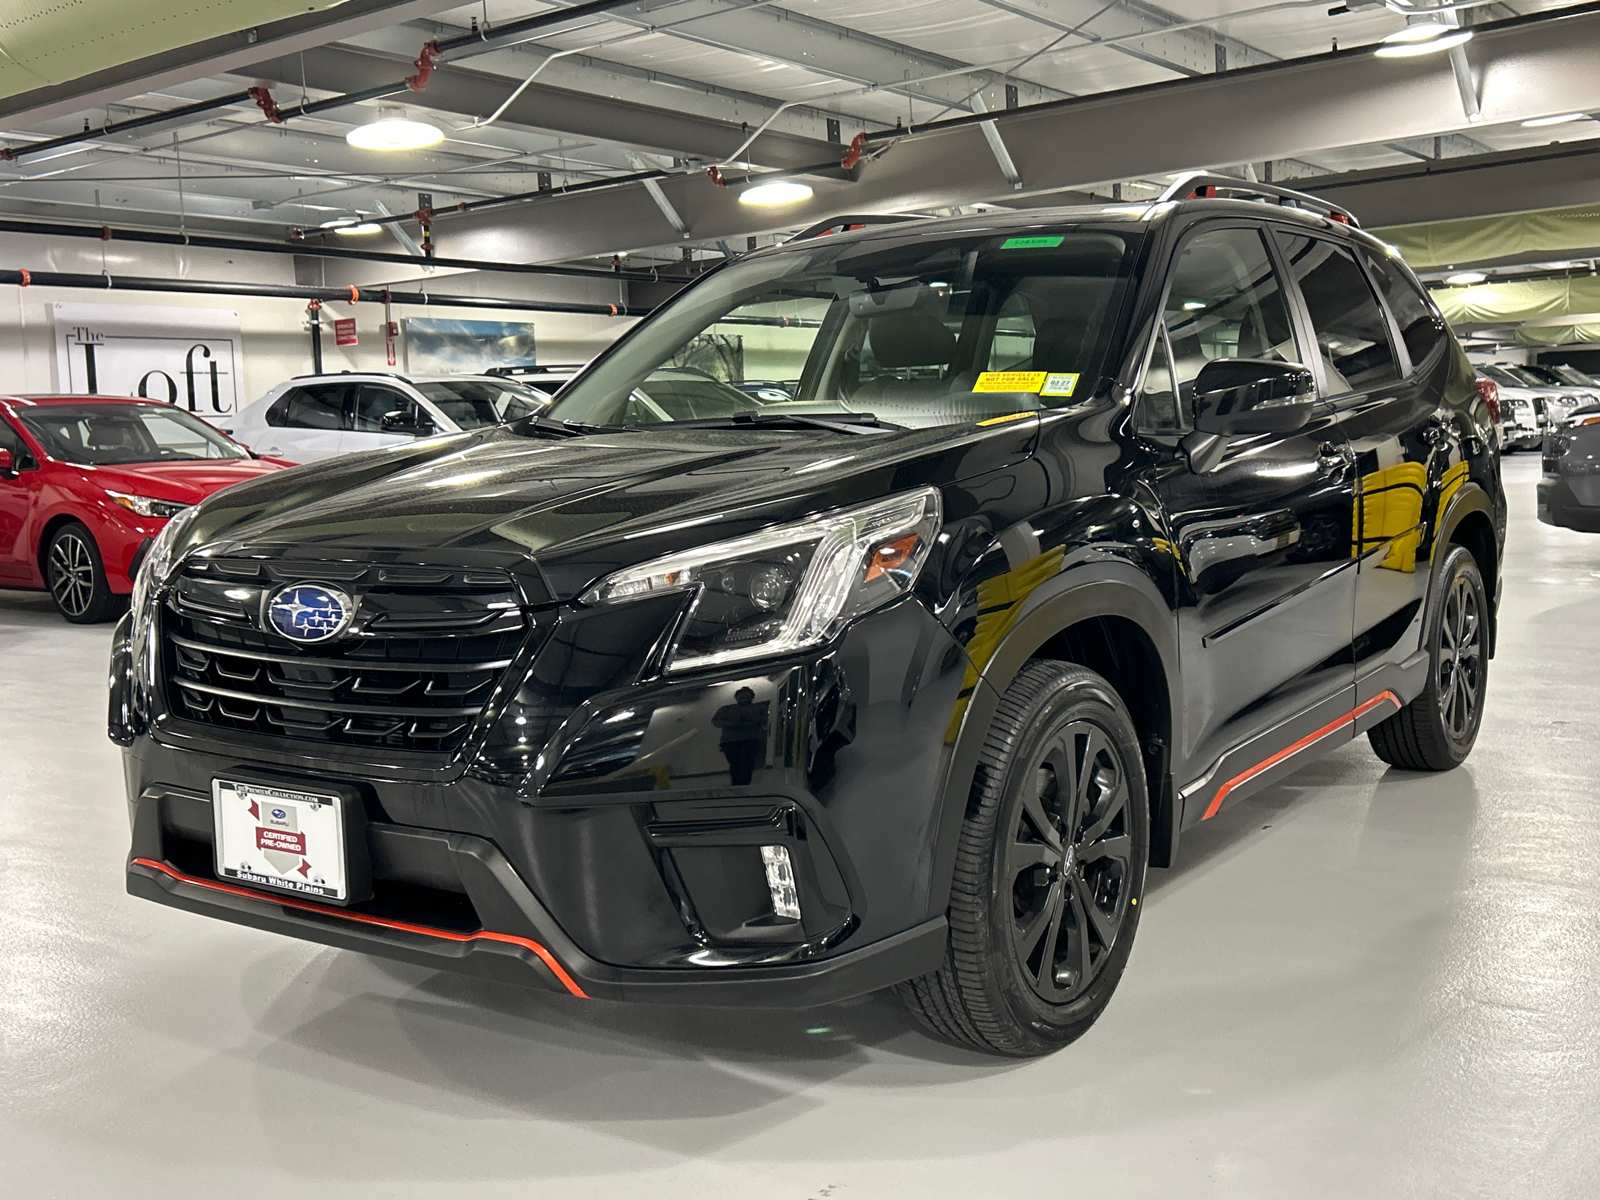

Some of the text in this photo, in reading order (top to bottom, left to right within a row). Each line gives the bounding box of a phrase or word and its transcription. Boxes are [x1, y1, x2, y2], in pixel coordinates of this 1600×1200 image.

[73, 326, 104, 342] The
[74, 343, 232, 413] Loft
[270, 819, 290, 827] SUBARU
[263, 831, 298, 843] CERTIFIED
[261, 838, 302, 851] PRE-OWNED
[236, 870, 324, 895] Subaru White Plains
